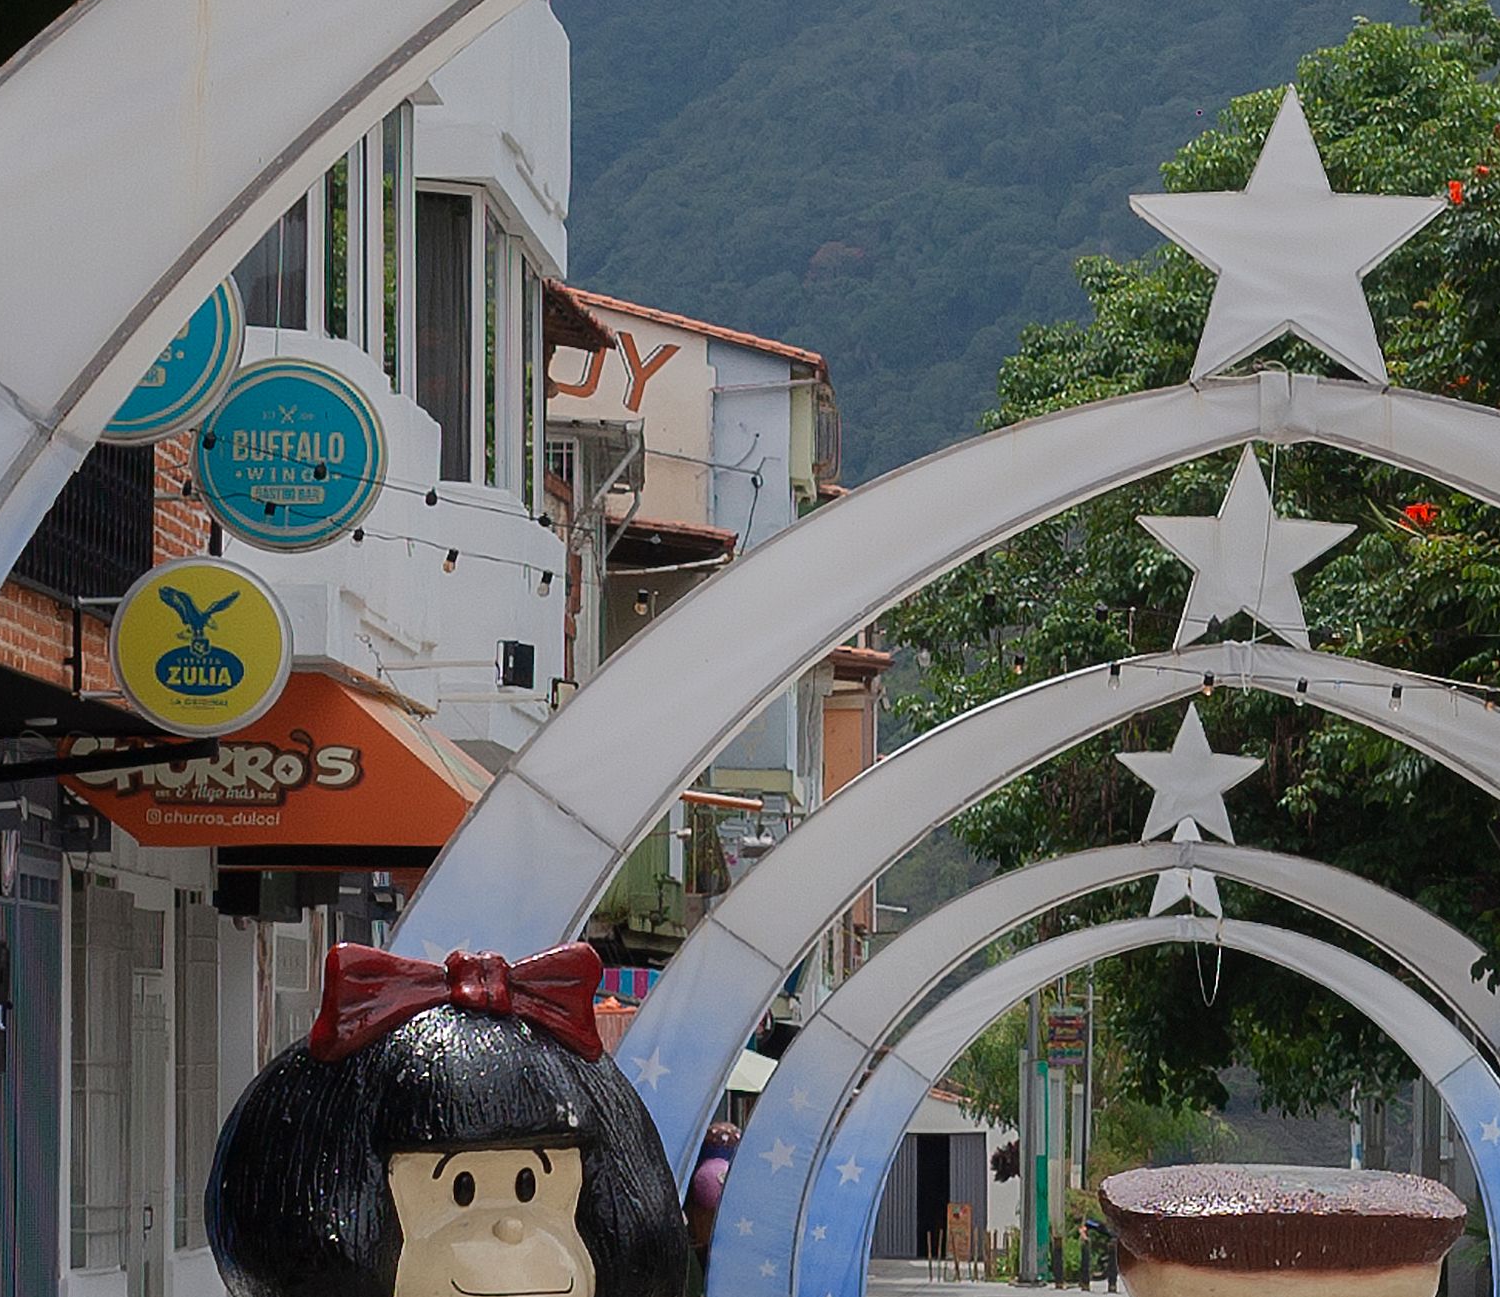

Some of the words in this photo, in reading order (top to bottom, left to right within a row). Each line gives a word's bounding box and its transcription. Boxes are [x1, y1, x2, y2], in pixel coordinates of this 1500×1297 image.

[233, 430, 345, 464] BUFFALO
[246, 468, 332, 483] WING
[166, 666, 232, 686] ZULIA
